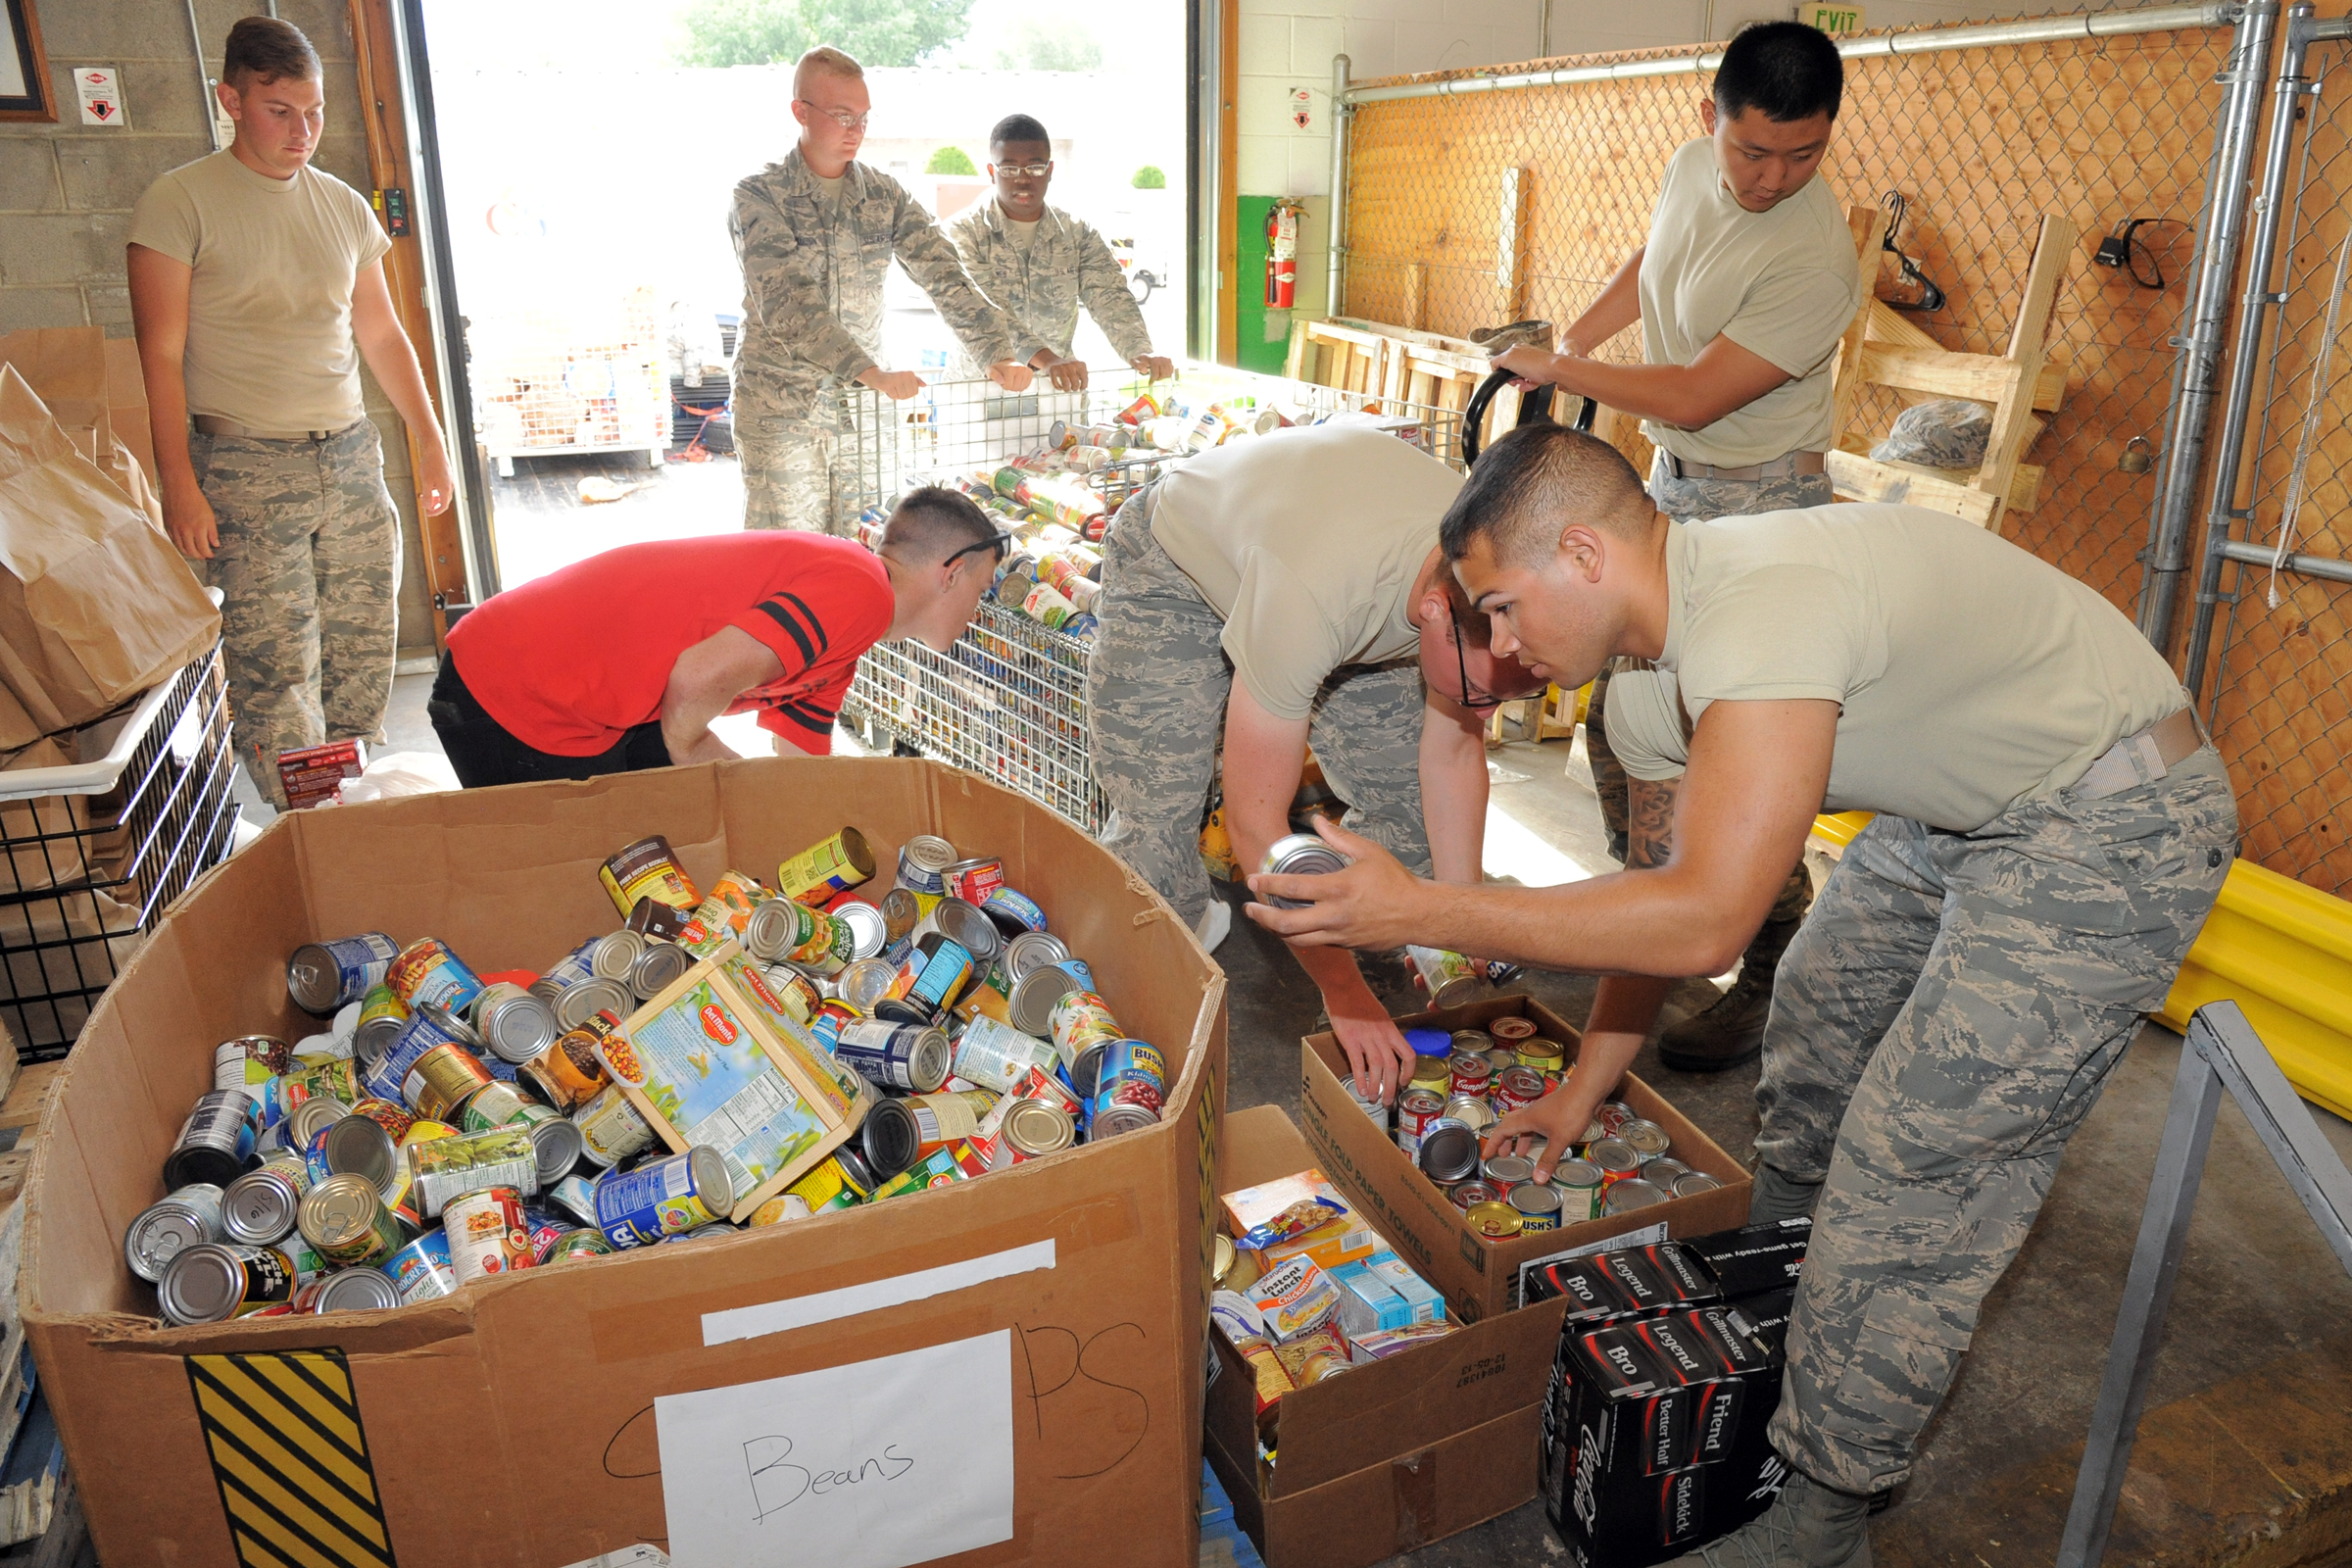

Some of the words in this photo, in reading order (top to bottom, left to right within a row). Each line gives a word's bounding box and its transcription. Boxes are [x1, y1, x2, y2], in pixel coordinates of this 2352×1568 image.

[586, 1013, 612, 1037] Black
[704, 1004, 718, 1020] Del
[712, 1015, 736, 1043] Monte
[1134, 1049, 1164, 1070] BUSH
[769, 1066, 788, 1088] Nutrition
[785, 1085, 798, 1100] Facts
[1456, 1078, 1491, 1092] Campbel
[1301, 1101, 1329, 1144] SINGLE
[1330, 1138, 1352, 1173] FOLD
[1355, 1172, 1386, 1212] PAPER
[1388, 1206, 1433, 1266] TOWELS
[1523, 1219, 1553, 1231] USH'S
[1712, 1251, 1734, 1261] with
[1735, 1240, 1788, 1259] game-ready
[397, 1253, 439, 1292] ROGRESO
[1261, 1265, 1301, 1296] Instant
[1262, 1260, 1293, 1284] Maruchan
[1610, 1255, 1652, 1298] Legend
[1661, 1246, 1697, 1291] Grillmaster
[1270, 1275, 1303, 1298] Lunch
[1278, 1283, 1308, 1305] Chicken
[1565, 1274, 1594, 1301] Bro
[1705, 1311, 1747, 1362] Grillmaster
[1759, 1315, 1783, 1330] with
[1605, 1345, 1638, 1376] Bro
[1653, 1324, 1698, 1371] Legend
[1461, 1352, 1506, 1376] 12-05-13
[1658, 1398, 1673, 1437] Better
[1704, 1393, 1733, 1451] Friend
[1657, 1438, 1670, 1465] Half
[742, 1433, 914, 1526] Beans
[1676, 1476, 1691, 1534] Sidekick
